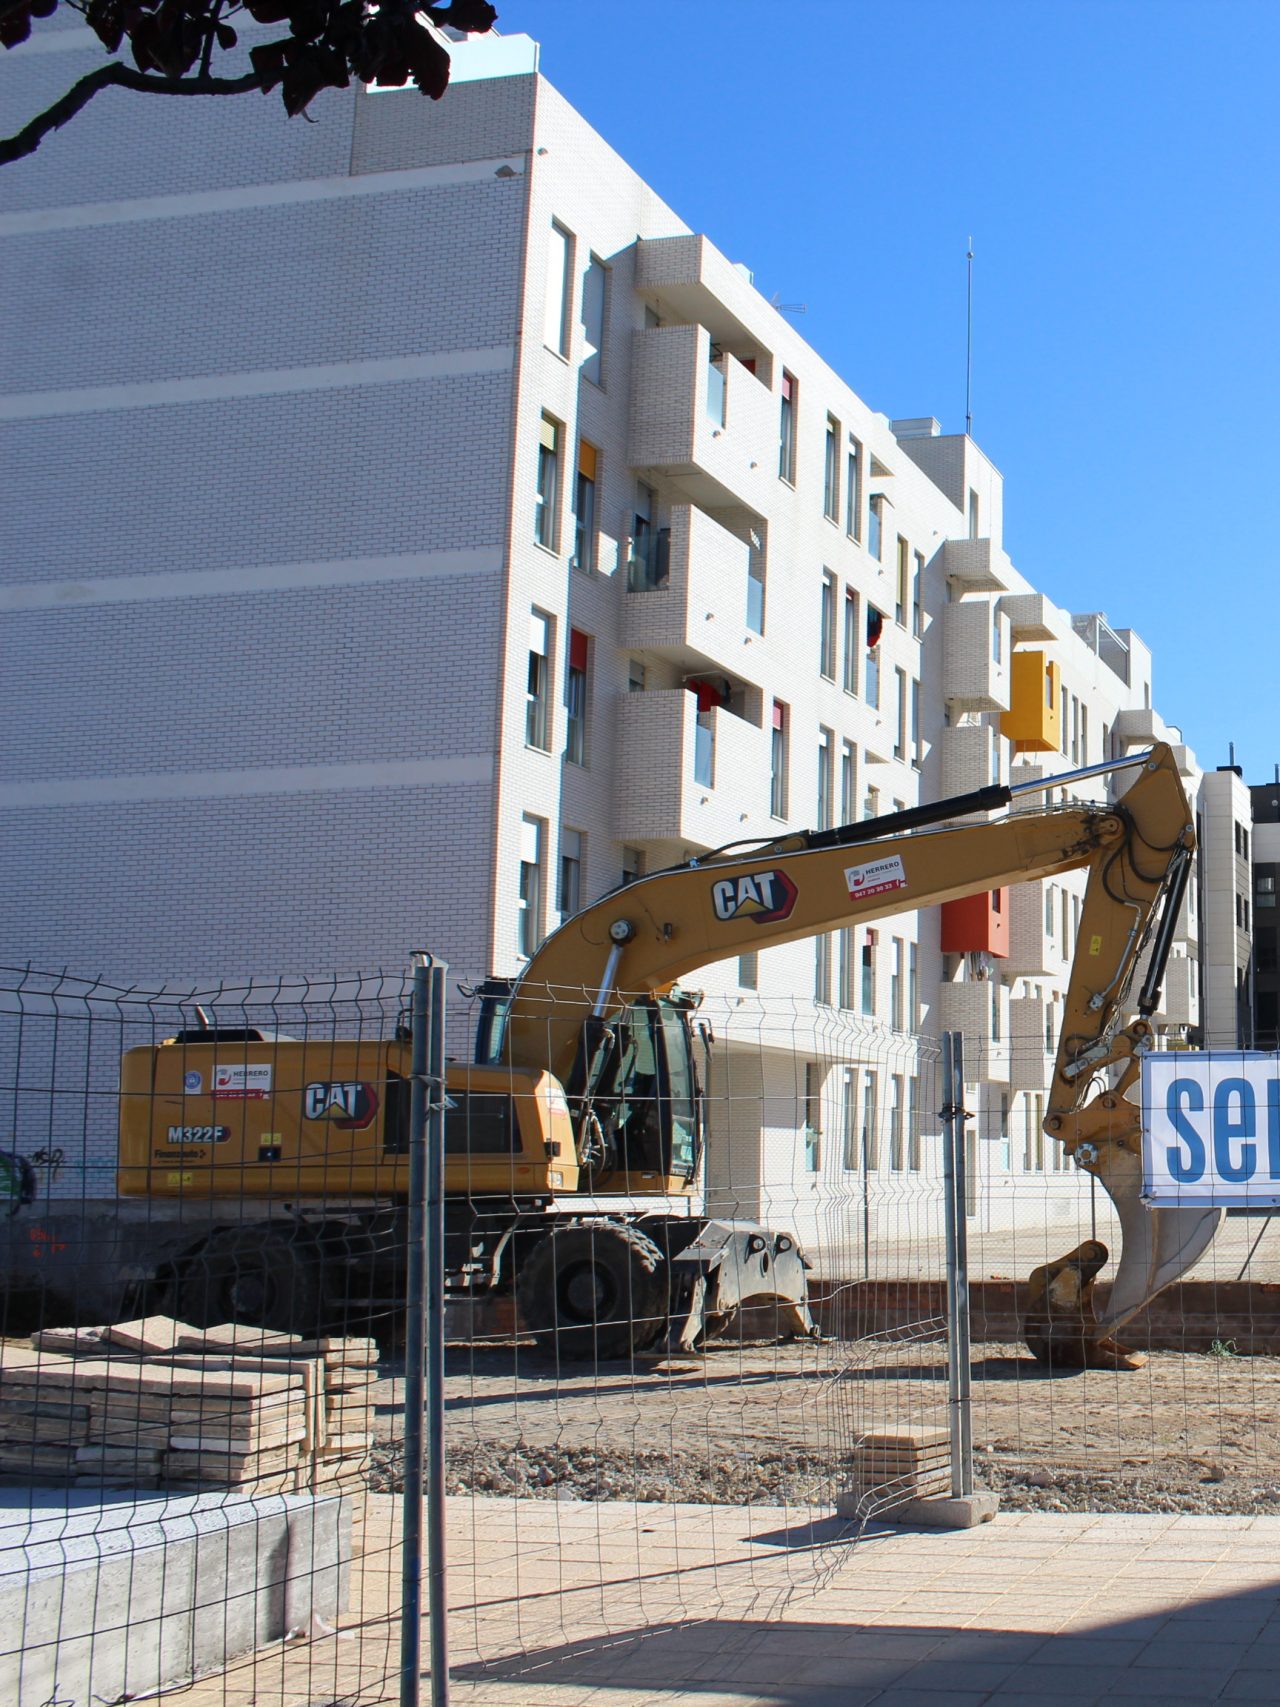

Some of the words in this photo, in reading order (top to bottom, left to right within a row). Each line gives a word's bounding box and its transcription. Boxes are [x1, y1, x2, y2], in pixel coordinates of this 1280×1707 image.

[865, 861, 900, 875] HERRERO
[713, 871, 775, 919] CAT
[306, 1082, 363, 1119] CAT
[168, 1126, 224, 1143] M322F
